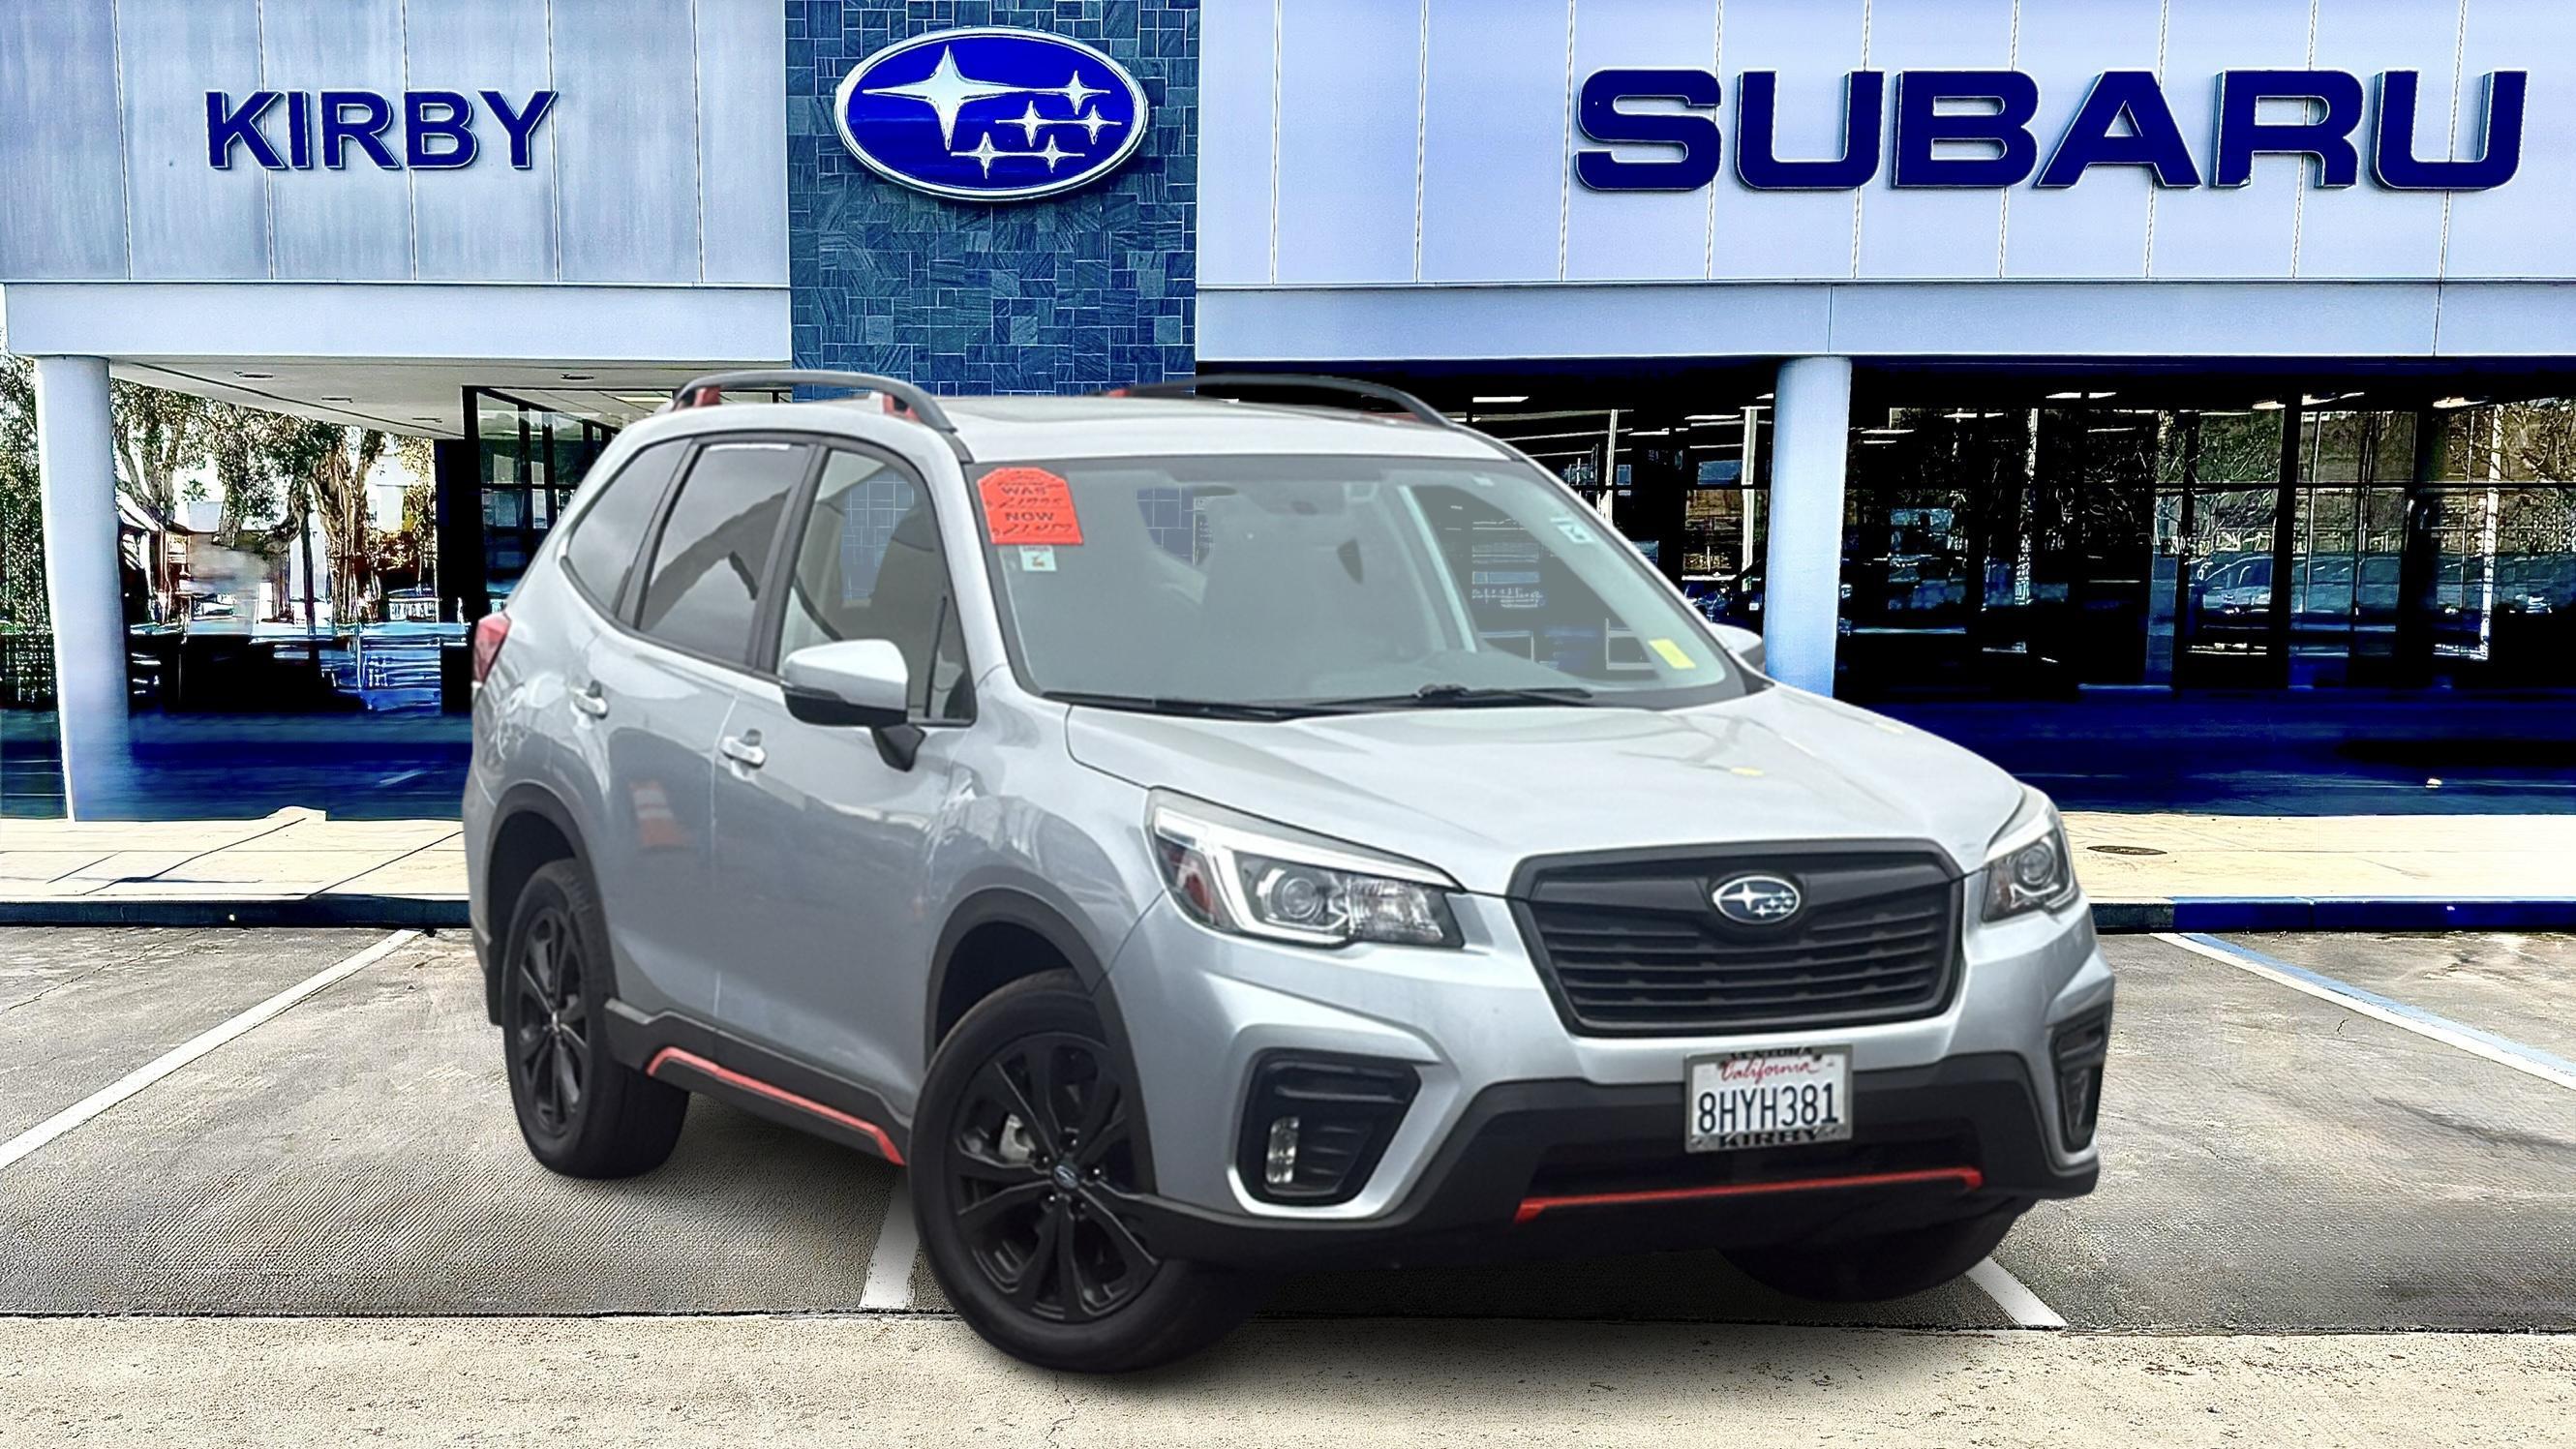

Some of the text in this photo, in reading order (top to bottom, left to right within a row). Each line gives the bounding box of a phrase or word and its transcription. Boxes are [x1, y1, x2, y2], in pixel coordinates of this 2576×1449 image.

[204, 90, 559, 170] KIRBY
[1575, 68, 2526, 192] SUBARU
[1001, 486, 1047, 496] WAS
[1005, 511, 1054, 521] NOW
[1721, 1057, 1820, 1084] California
[1698, 1082, 1838, 1133] 8HYH381
[1719, 1128, 1819, 1147] KIRBY
